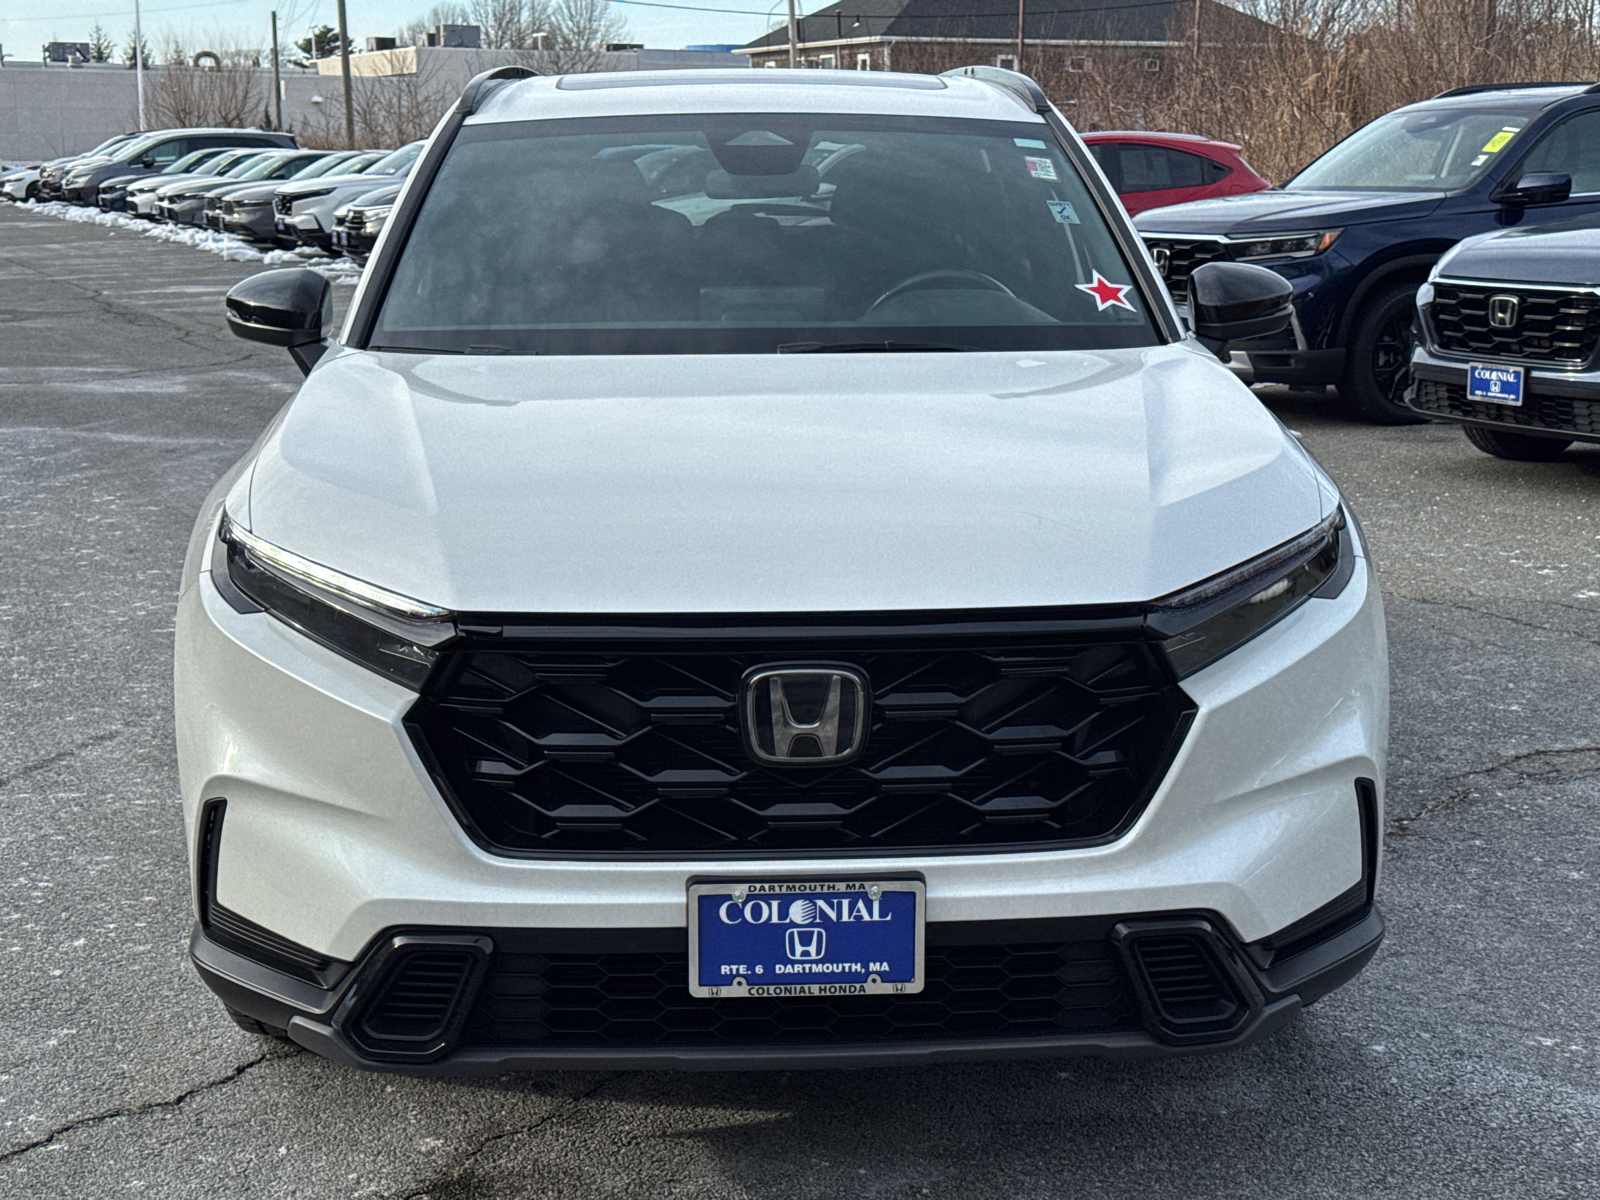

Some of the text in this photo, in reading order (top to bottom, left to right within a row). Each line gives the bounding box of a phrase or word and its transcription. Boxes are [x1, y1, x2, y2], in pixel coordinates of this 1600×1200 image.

[748, 883, 866, 893] DARTMOUTH, MA
[719, 898, 891, 924] COLONIAL
[720, 962, 890, 975] RTE. 6 DARTMOUTH, MA
[747, 984, 867, 996] COLONIAL HONDA
